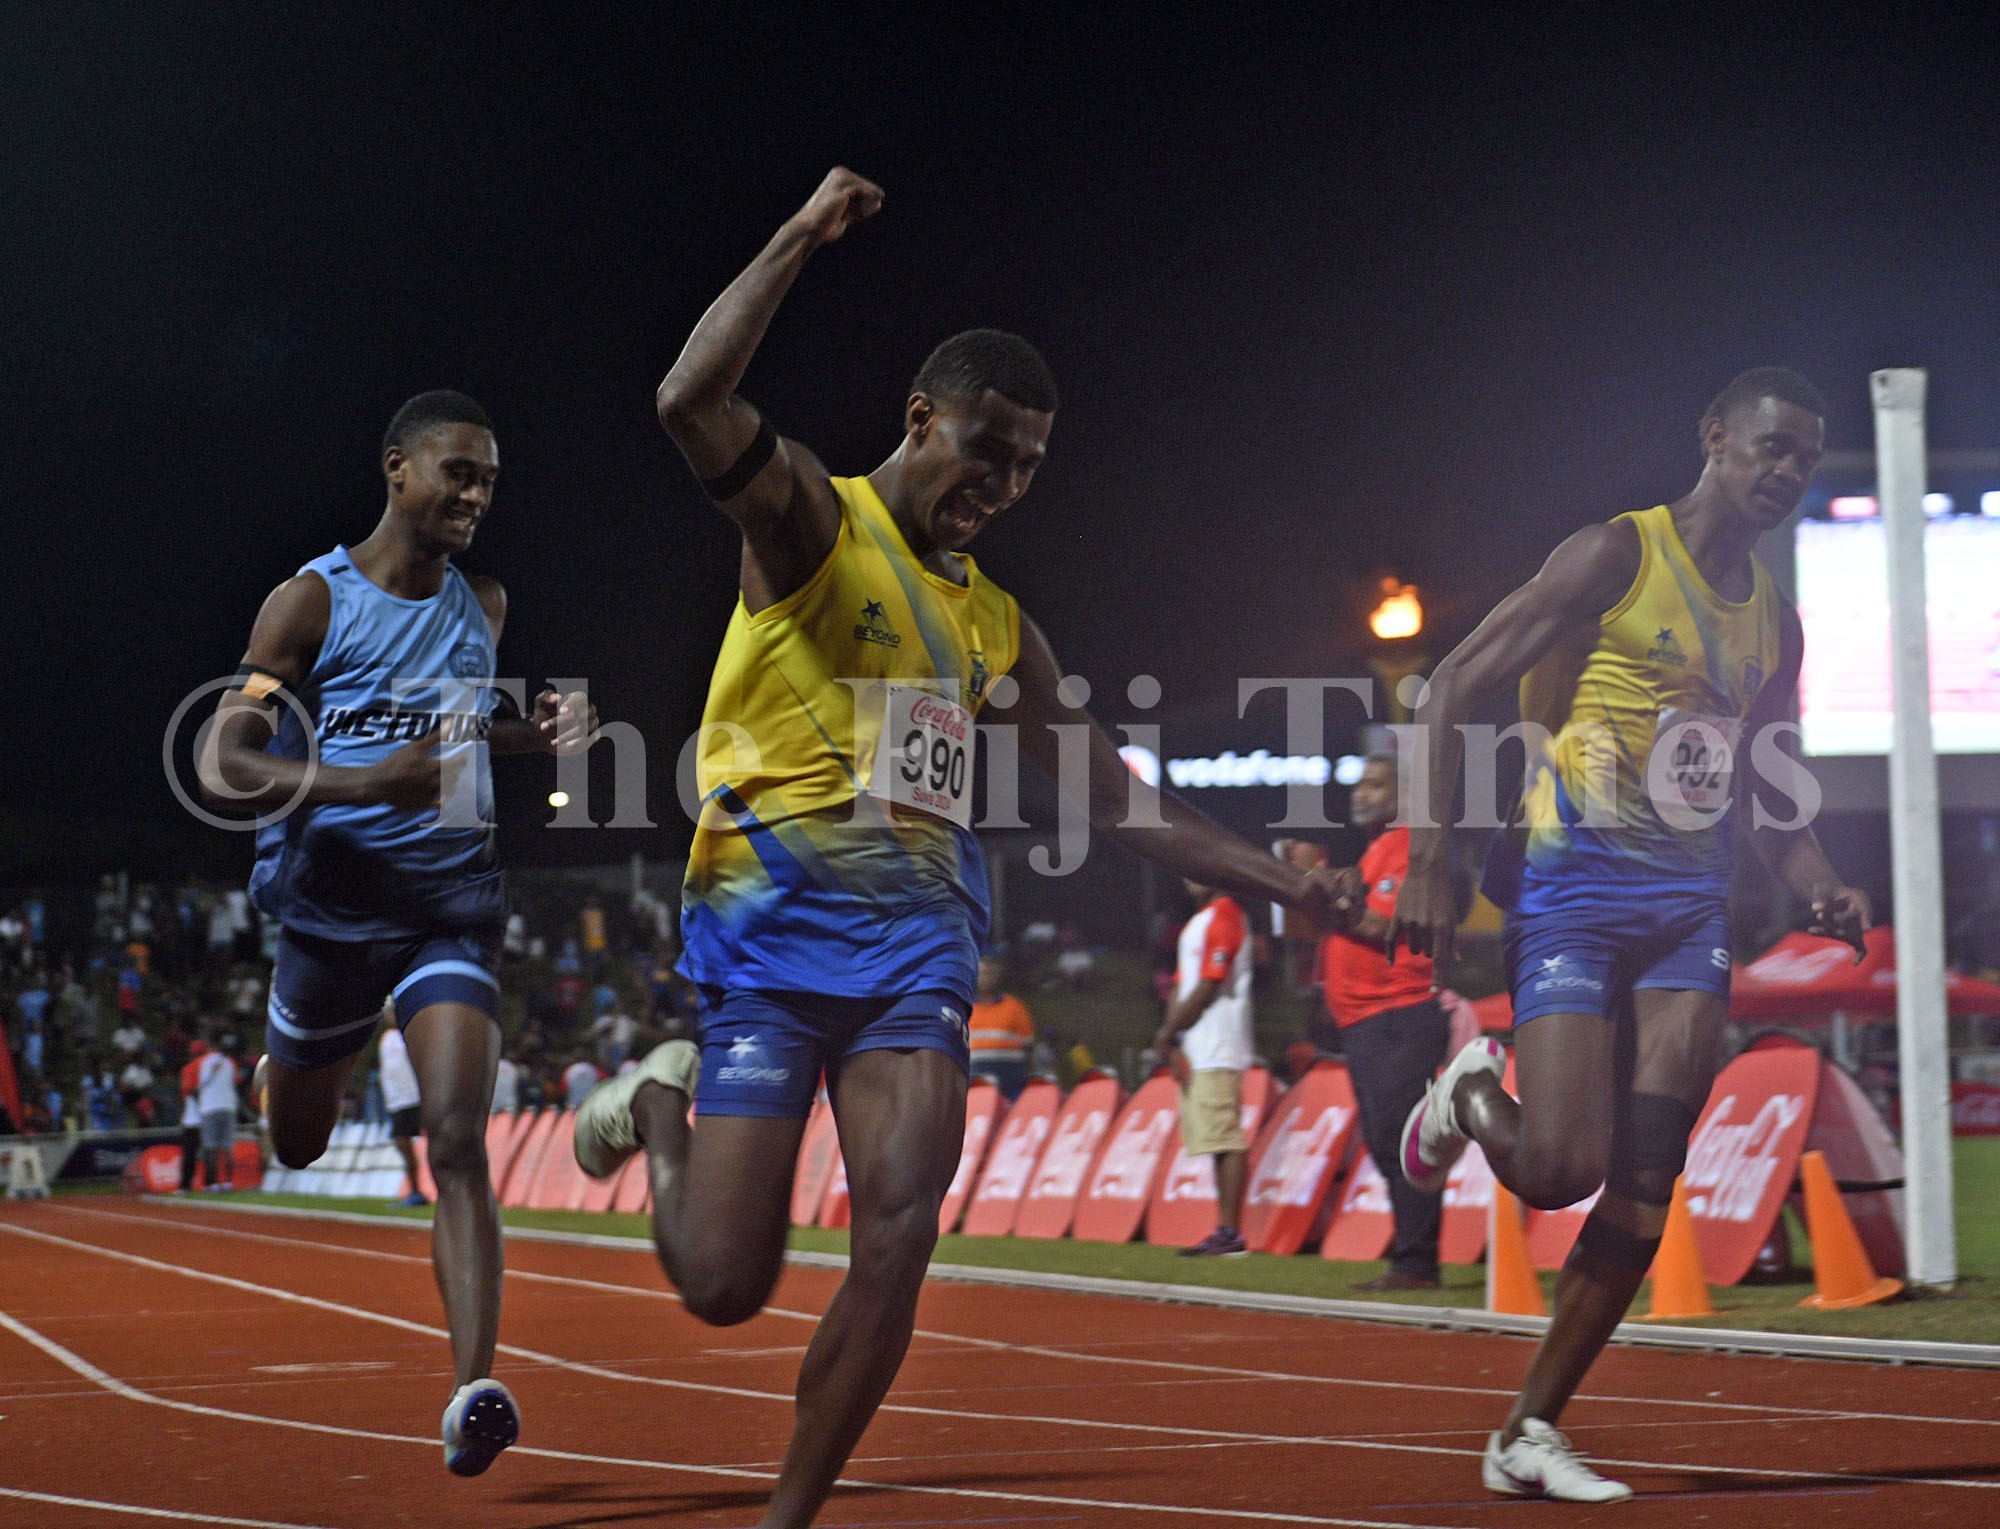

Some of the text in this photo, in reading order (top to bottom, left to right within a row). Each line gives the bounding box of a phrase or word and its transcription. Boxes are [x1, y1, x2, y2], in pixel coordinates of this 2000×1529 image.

[854, 623, 902, 645] BEYOND
[901, 729, 966, 800] 990
[1666, 742, 1727, 790] 992
[716, 1066, 791, 1081] BEYOND
